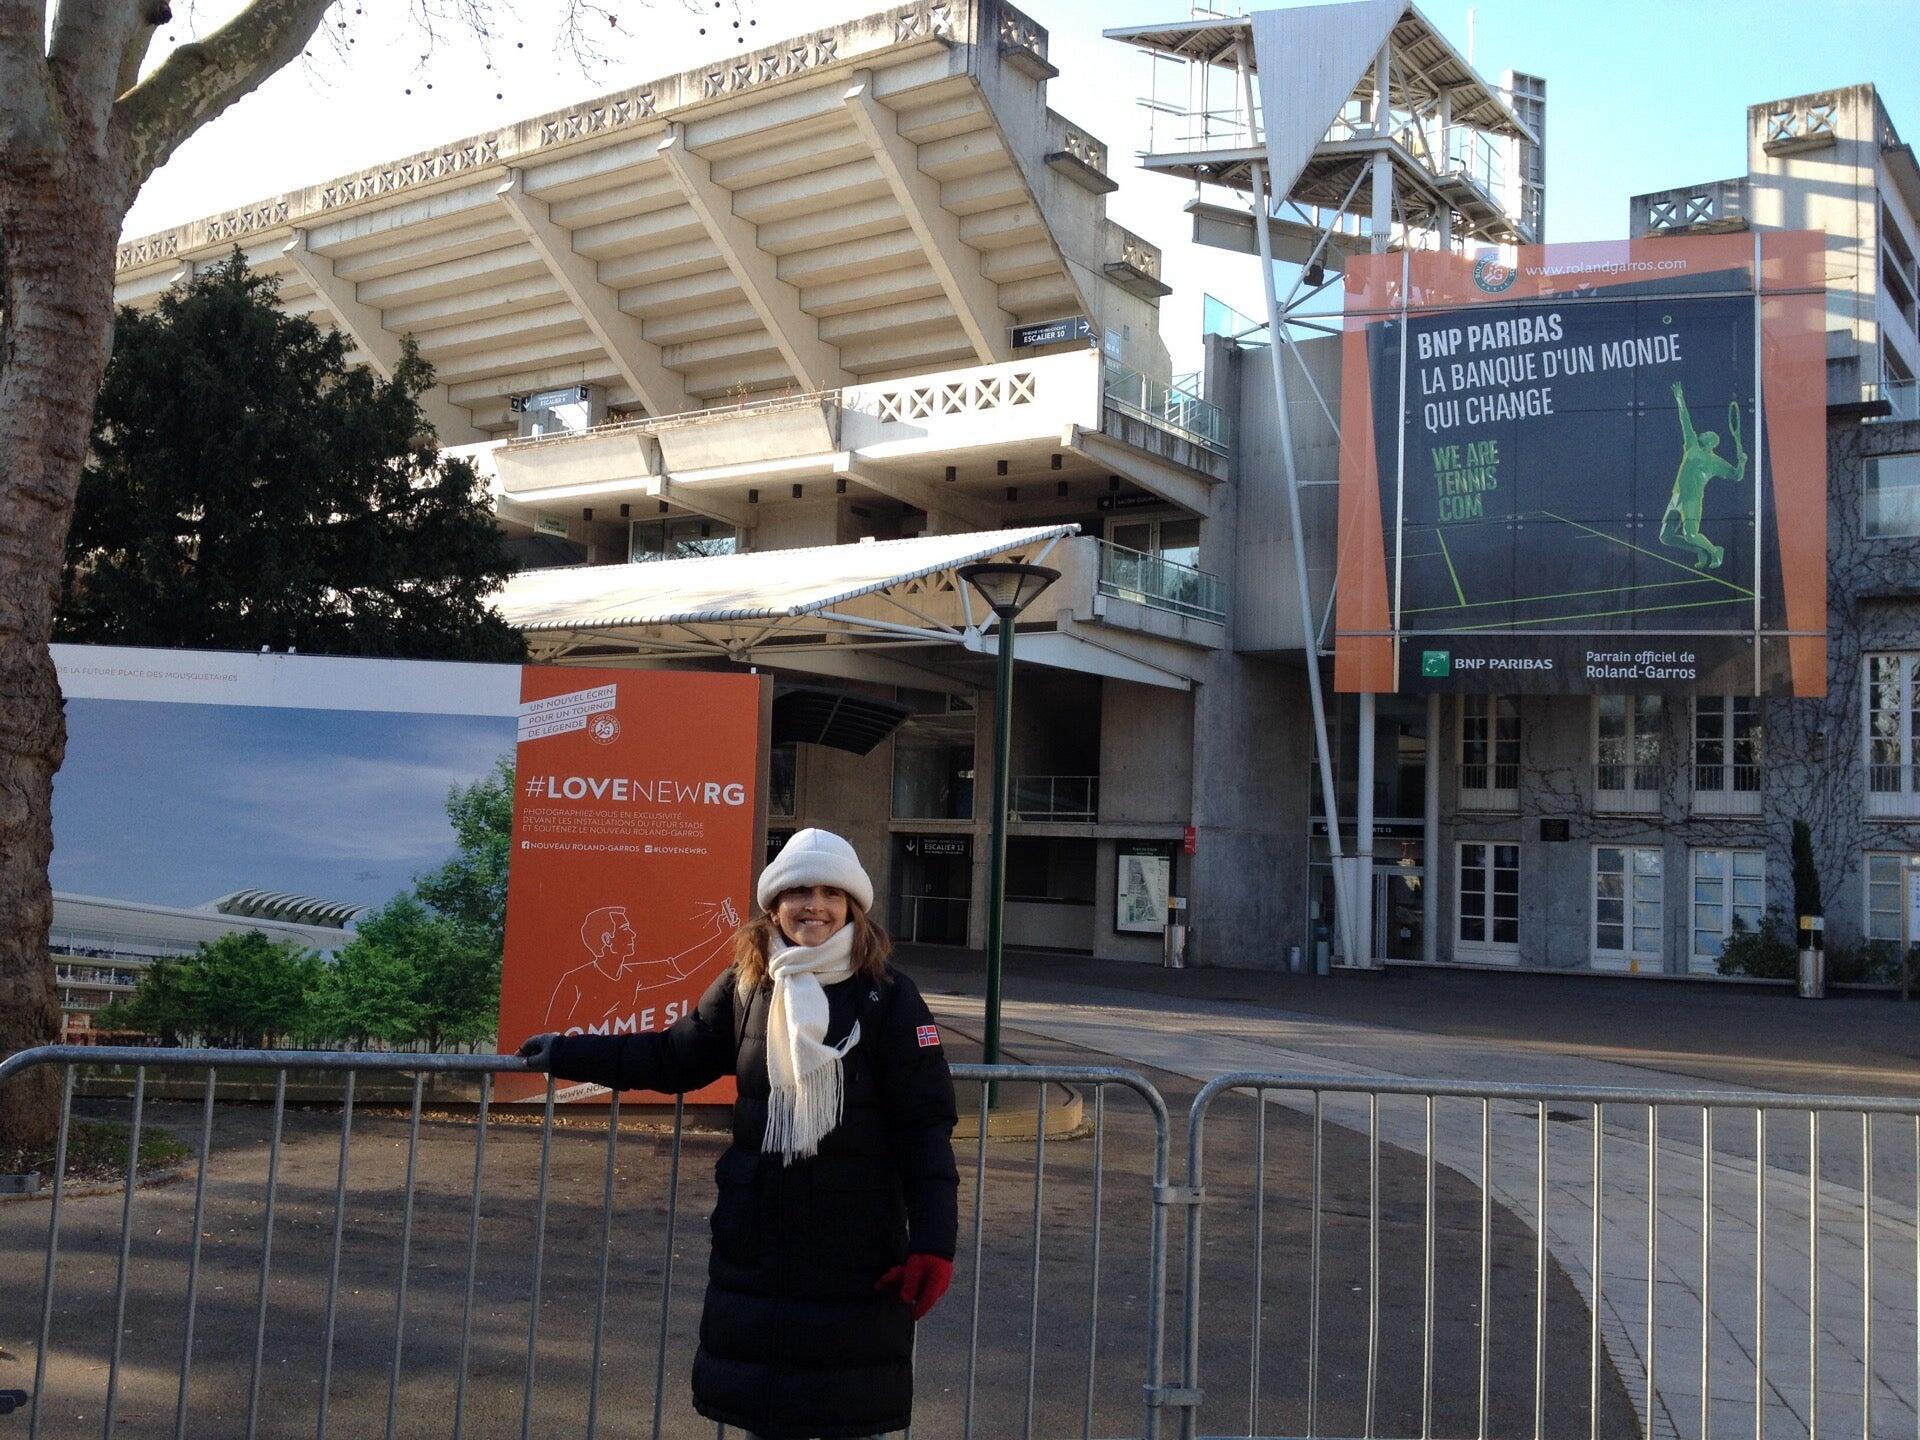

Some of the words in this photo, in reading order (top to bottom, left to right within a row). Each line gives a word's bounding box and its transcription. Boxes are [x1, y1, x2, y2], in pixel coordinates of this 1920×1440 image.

[1525, 259, 1687, 276] www.rolandgarros.com
[1023, 332, 1055, 344] ESCALIER
[1417, 328, 1462, 360] BNP
[1467, 313, 1563, 352] PARIBAS
[1421, 366, 1446, 395] LA
[1451, 353, 1538, 391] BANQUE
[1542, 345, 1595, 379] D'UN
[1601, 334, 1682, 371] MONDE
[1424, 400, 1460, 433] QUI
[1466, 387, 1554, 424] CHANGE
[1431, 444, 1461, 471] WE
[1467, 440, 1500, 467] ARE
[1434, 466, 1497, 496] TENNIS
[1454, 658, 1486, 670] BNP
[1489, 658, 1553, 670] PARIBAS
[1586, 651, 1631, 662] Parrain
[1634, 651, 1676, 664] officiel
[1680, 652, 1695, 663] de
[118, 669, 144, 678] PLACE
[147, 670, 163, 678] DES
[164, 672, 238, 682] MOUSQUETAIRES
[1586, 665, 1696, 679] Roland-Garros
[530, 702, 544, 712] UN
[546, 694, 584, 707] NOUVEL
[528, 714, 554, 724] POUR
[556, 710, 570, 719] UN
[572, 701, 613, 715] TOURNOI
[528, 729, 541, 738] DE
[525, 775, 746, 806] #LOVENEWRG
[523, 816, 556, 824] DEVANT
[574, 818, 635, 827] INSTALLATIONS
[652, 820, 677, 828] FUTUR
[680, 822, 704, 830] STADE
[534, 824, 577, 833] SOUTENEZ
[590, 826, 631, 835] NOUVEAU
[633, 828, 704, 838] ROLAND-GARROS
[530, 842, 570, 850] NOUVEAU
[572, 843, 640, 852] ROLAND-GARROS
[653, 846, 708, 855] #LOVENEWRG
